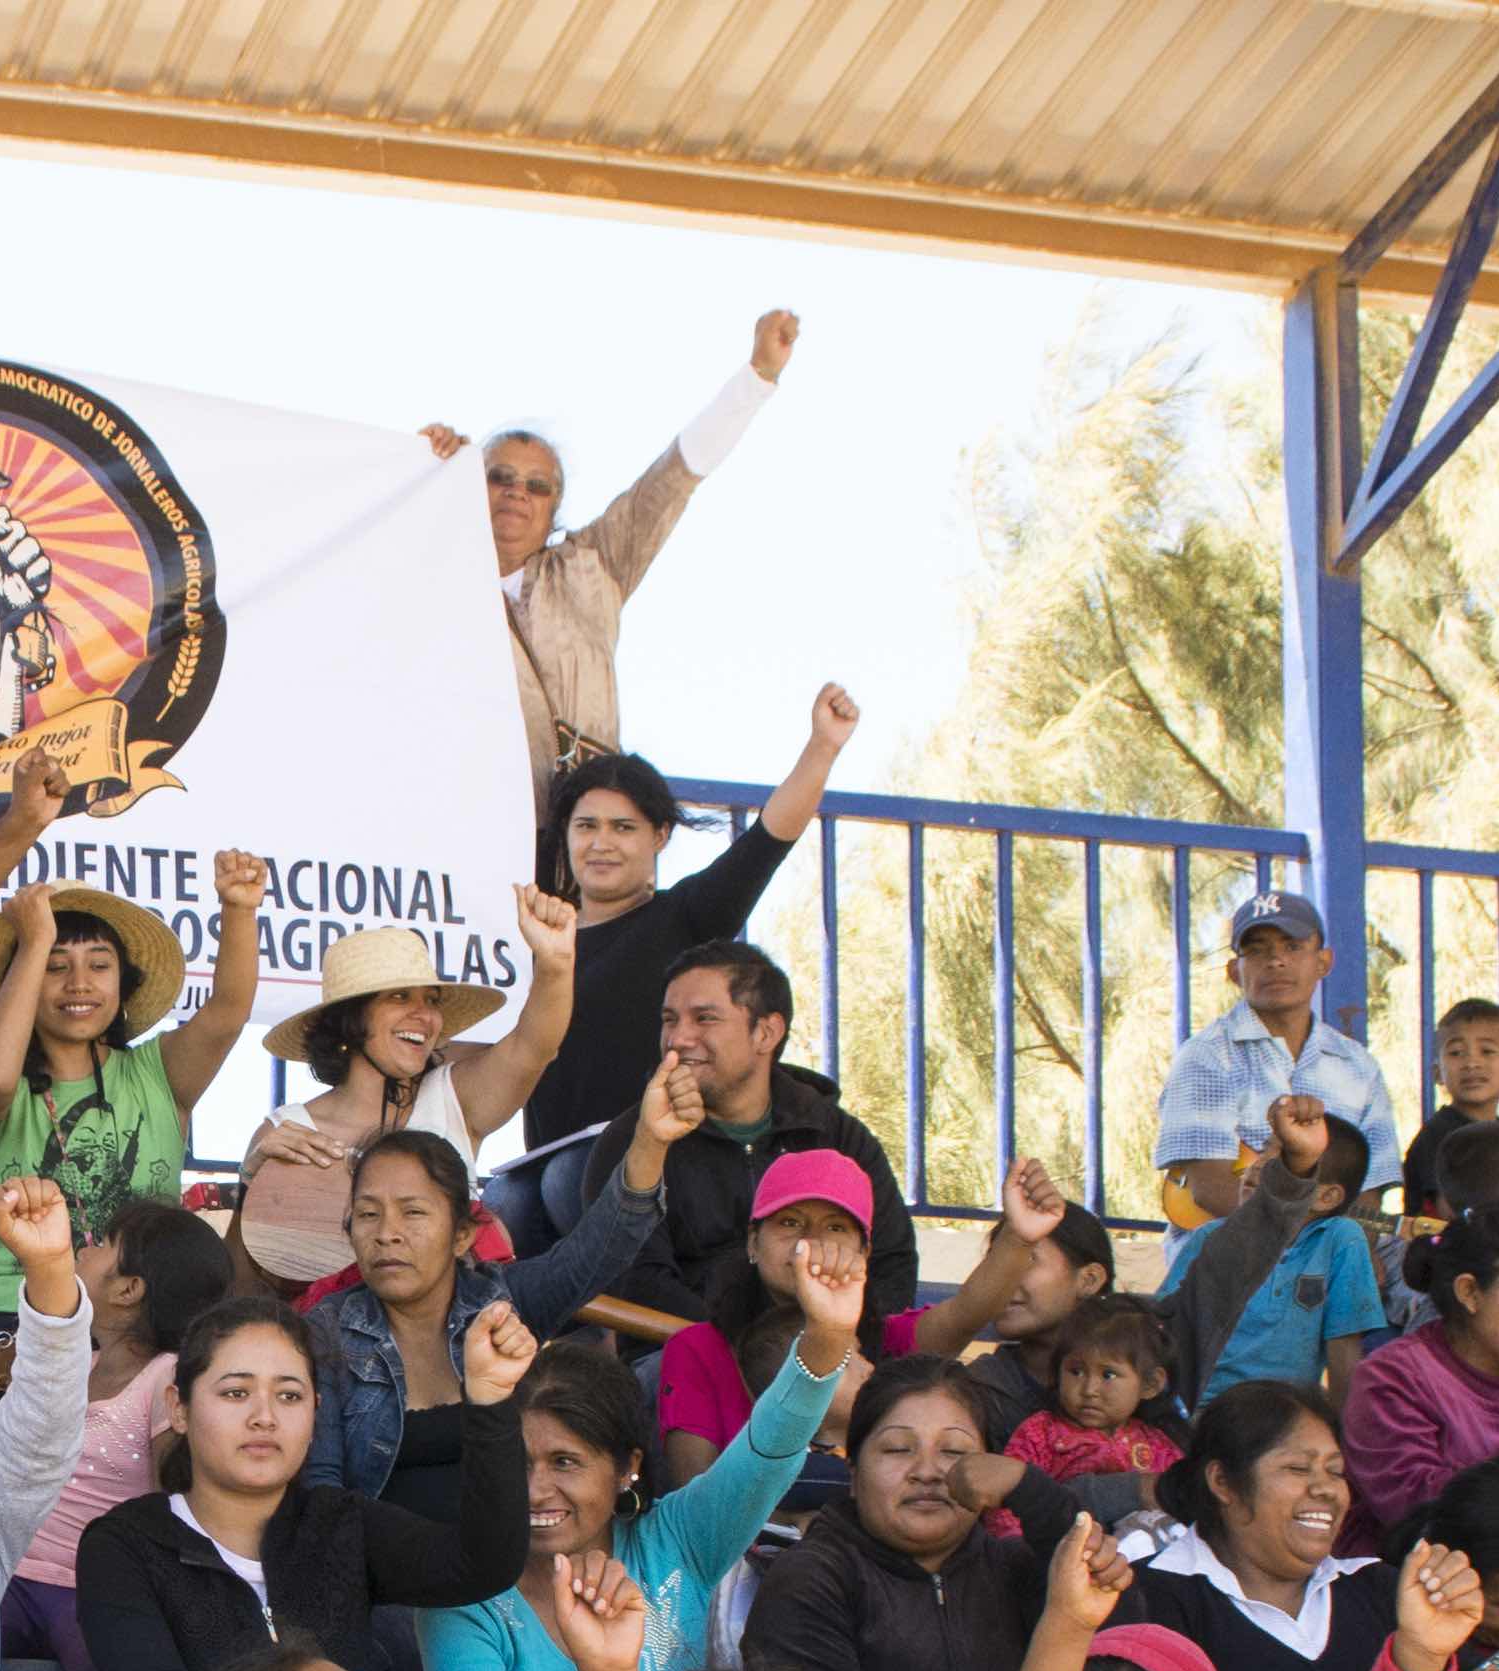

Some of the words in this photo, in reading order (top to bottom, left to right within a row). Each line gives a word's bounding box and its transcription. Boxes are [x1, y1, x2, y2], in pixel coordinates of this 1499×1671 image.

[92, 411, 118, 439] DE
[111, 431, 191, 533] JORNALEROS
[178, 534, 205, 630] AGRICOLA
[218, 857, 466, 925] ACIONAL
